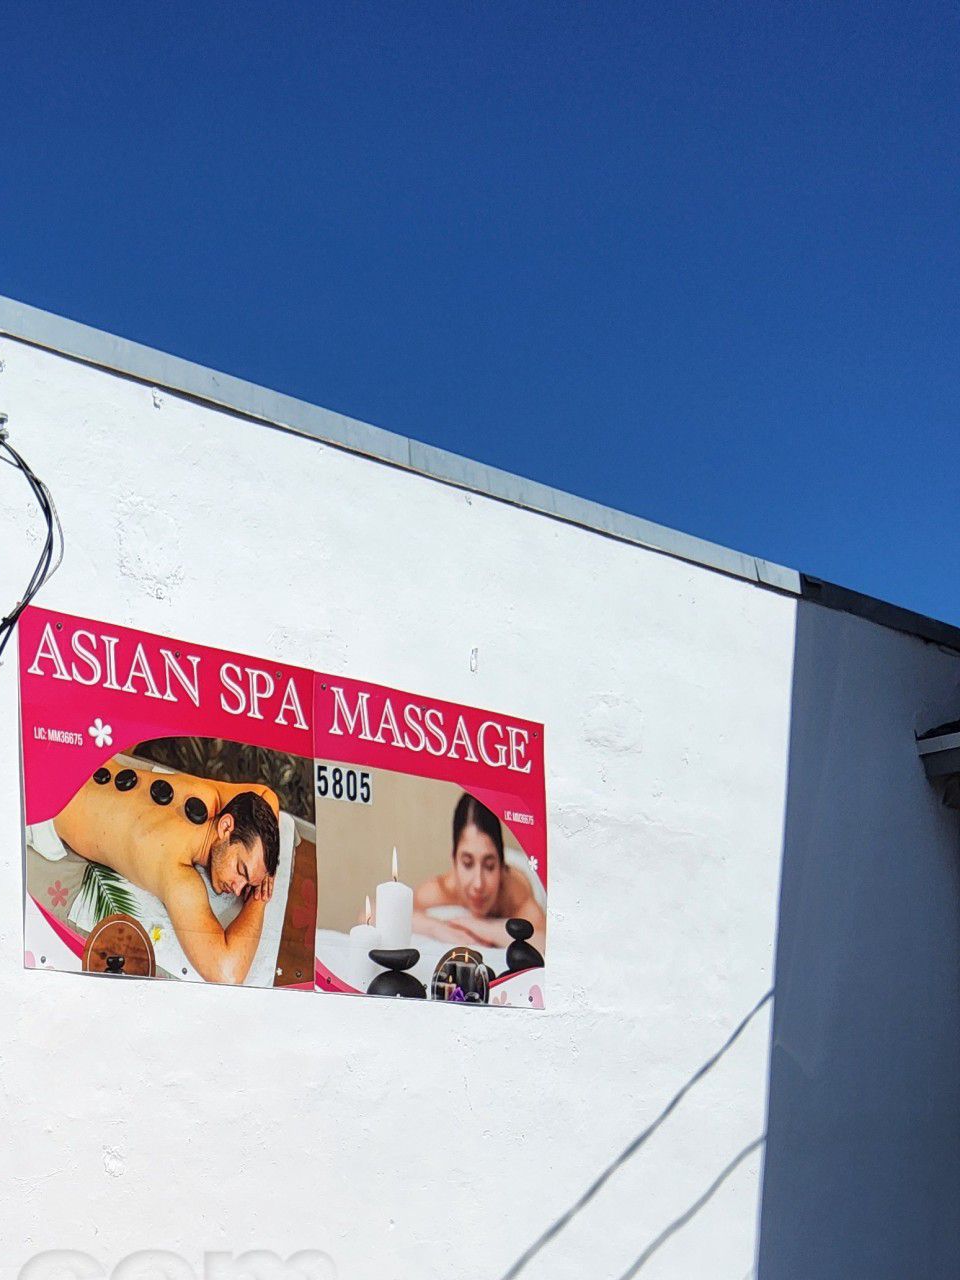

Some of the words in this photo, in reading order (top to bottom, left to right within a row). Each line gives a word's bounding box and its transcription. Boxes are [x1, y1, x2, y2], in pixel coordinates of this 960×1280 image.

[27, 622, 201, 707] ASIAN
[219, 662, 309, 730] SPA
[329, 686, 532, 774] MASSAGE
[317, 765, 371, 803] 5805
